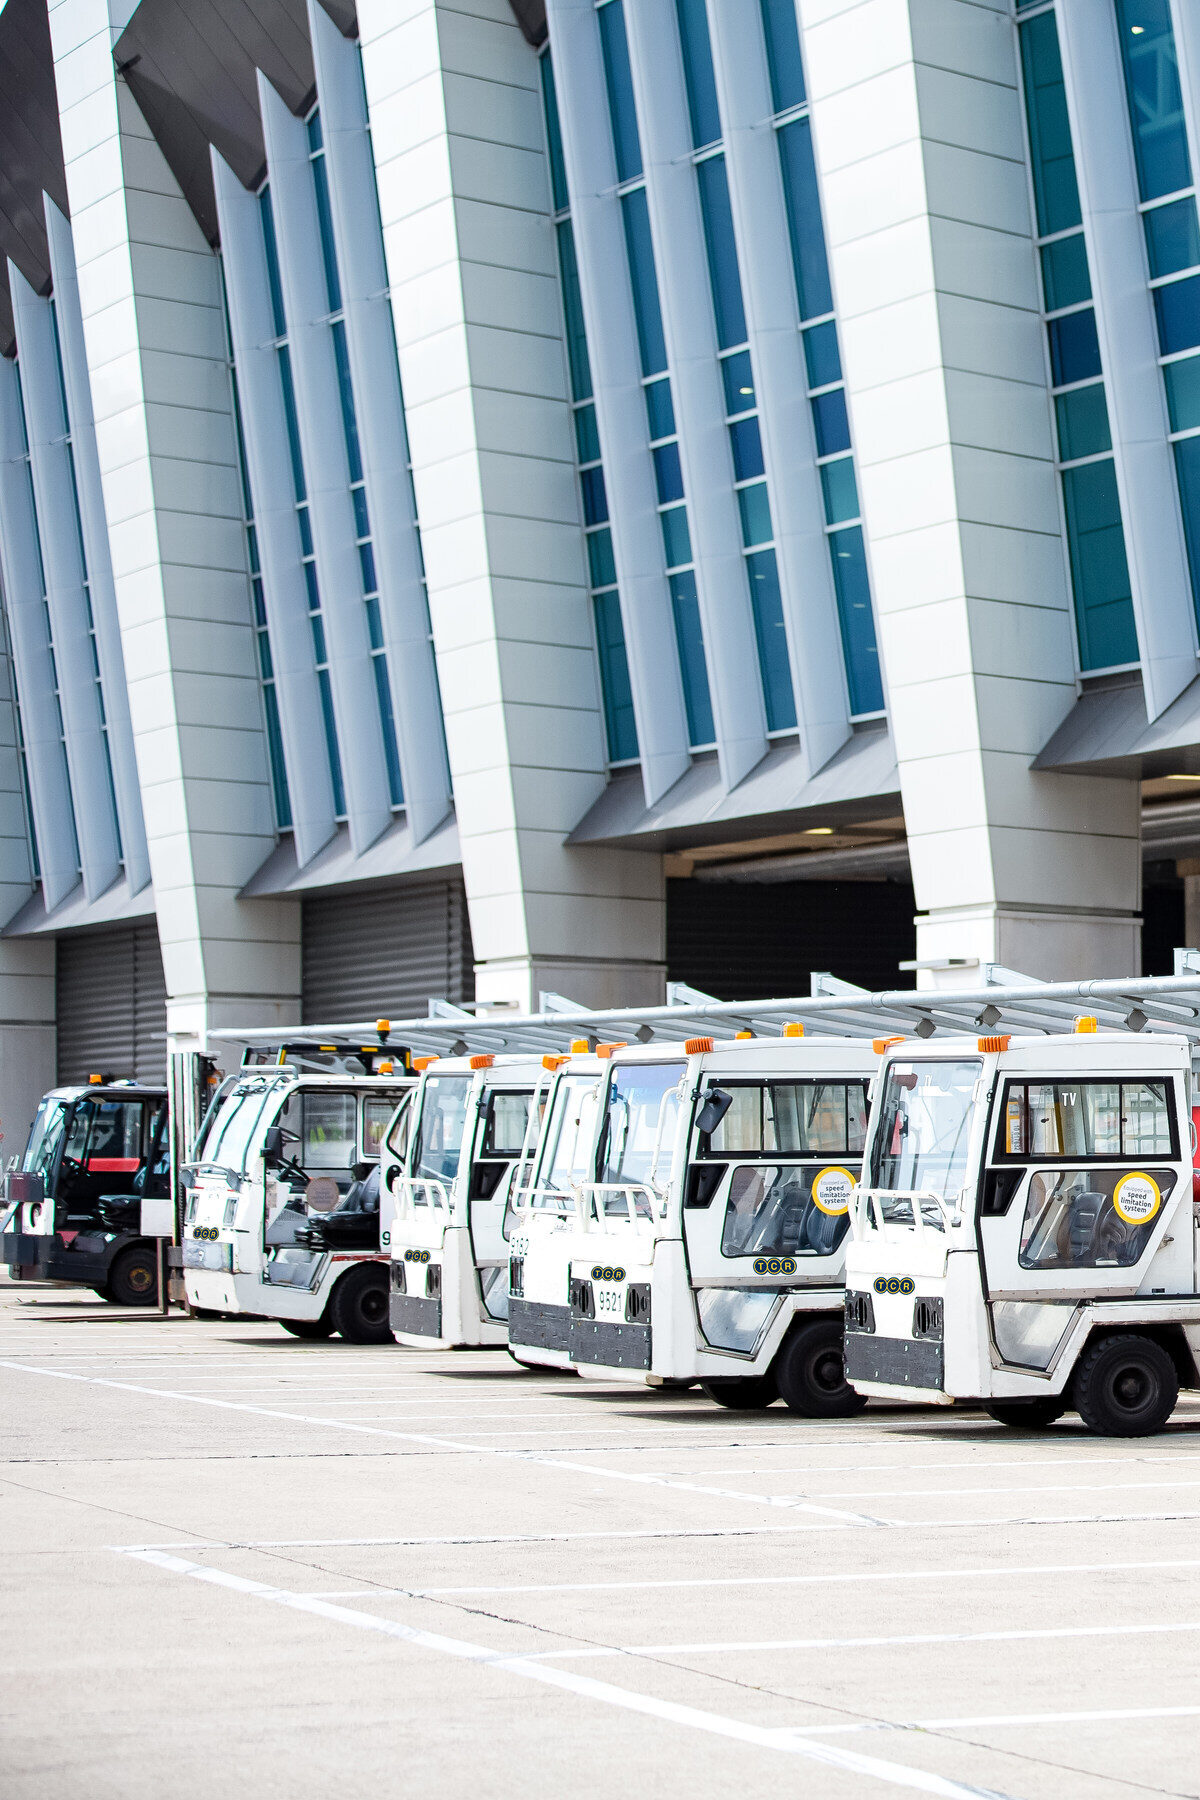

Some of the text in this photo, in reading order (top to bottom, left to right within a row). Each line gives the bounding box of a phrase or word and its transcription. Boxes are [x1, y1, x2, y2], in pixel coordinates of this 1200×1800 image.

[1062, 1092, 1077, 1107] TV
[824, 1197, 847, 1205] system
[1127, 1192, 1147, 1200] speed
[1120, 1197, 1152, 1208] limitation
[1124, 1205, 1147, 1213] system
[195, 1228, 217, 1240] TCR
[406, 1251, 429, 1263] TCR
[756, 1260, 793, 1273] TCR
[594, 1268, 623, 1280] TCR
[877, 1280, 912, 1293] TCR
[599, 1290, 622, 1312] 9521
